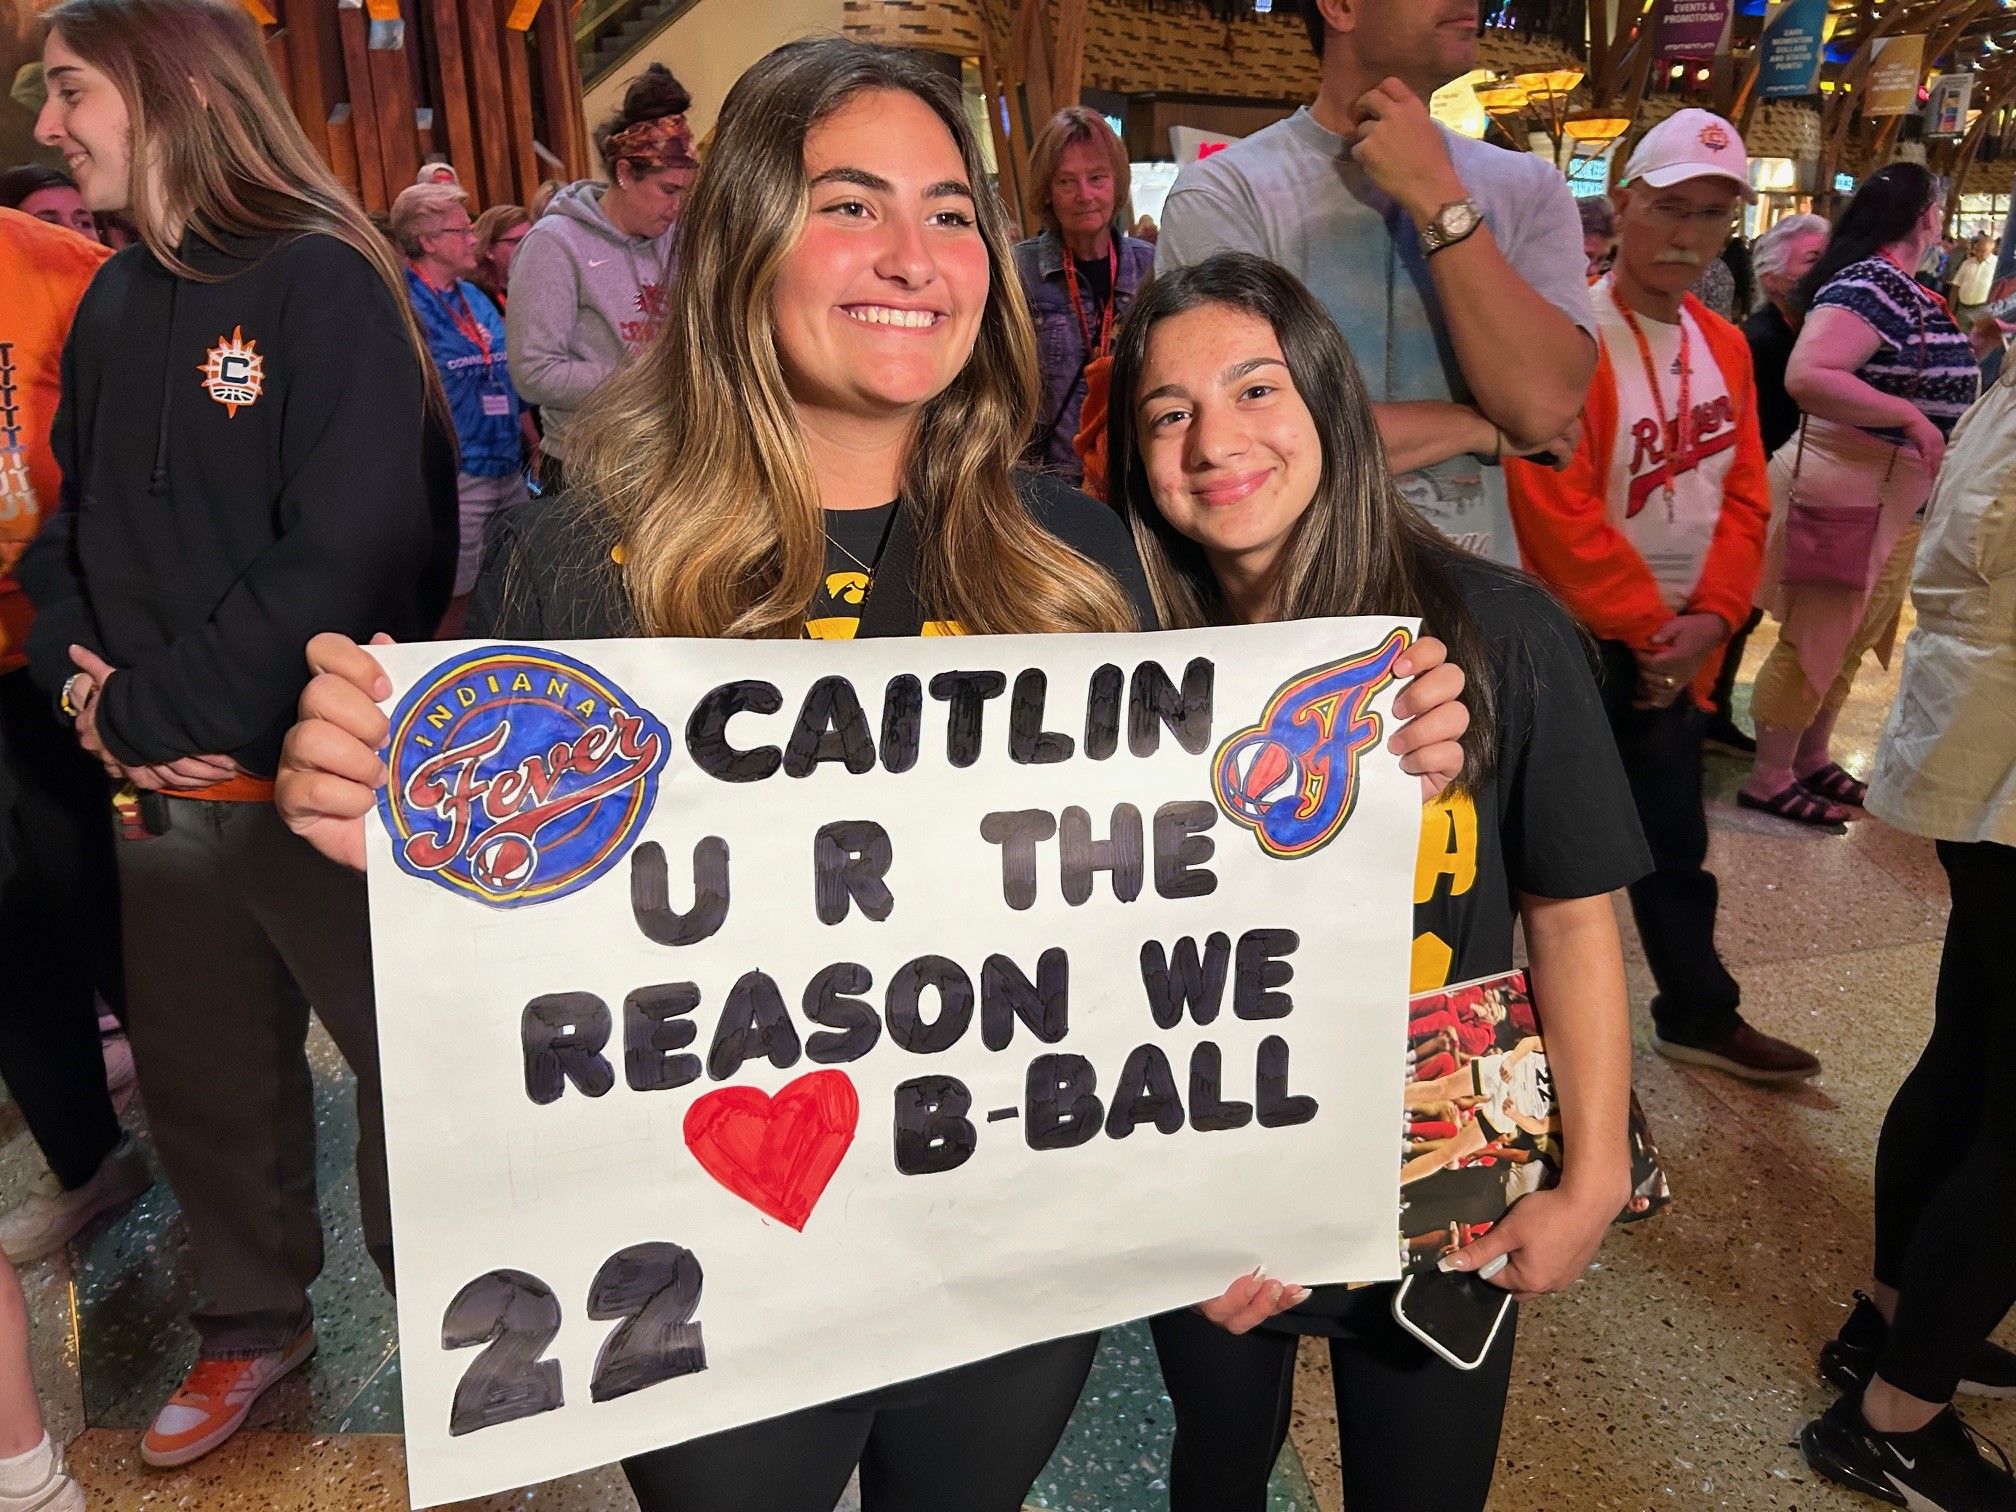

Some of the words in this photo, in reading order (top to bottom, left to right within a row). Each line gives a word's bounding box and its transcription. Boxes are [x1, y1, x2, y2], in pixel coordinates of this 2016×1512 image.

[1673, 2, 1707, 13] EVENTS
[1708, 2, 1716, 12] &
[220, 356, 250, 385] C
[414, 672, 598, 749] INDIANA
[685, 656, 1215, 784] CAITLIN
[403, 708, 663, 870] Fever
[630, 835, 731, 947] U
[814, 820, 895, 925] R
[980, 800, 1219, 912] THE
[520, 946, 1070, 1106] REASON
[1139, 928, 1300, 1030] WE
[893, 1034, 1320, 1177] B-BALL
[441, 1241, 710, 1438] 22
